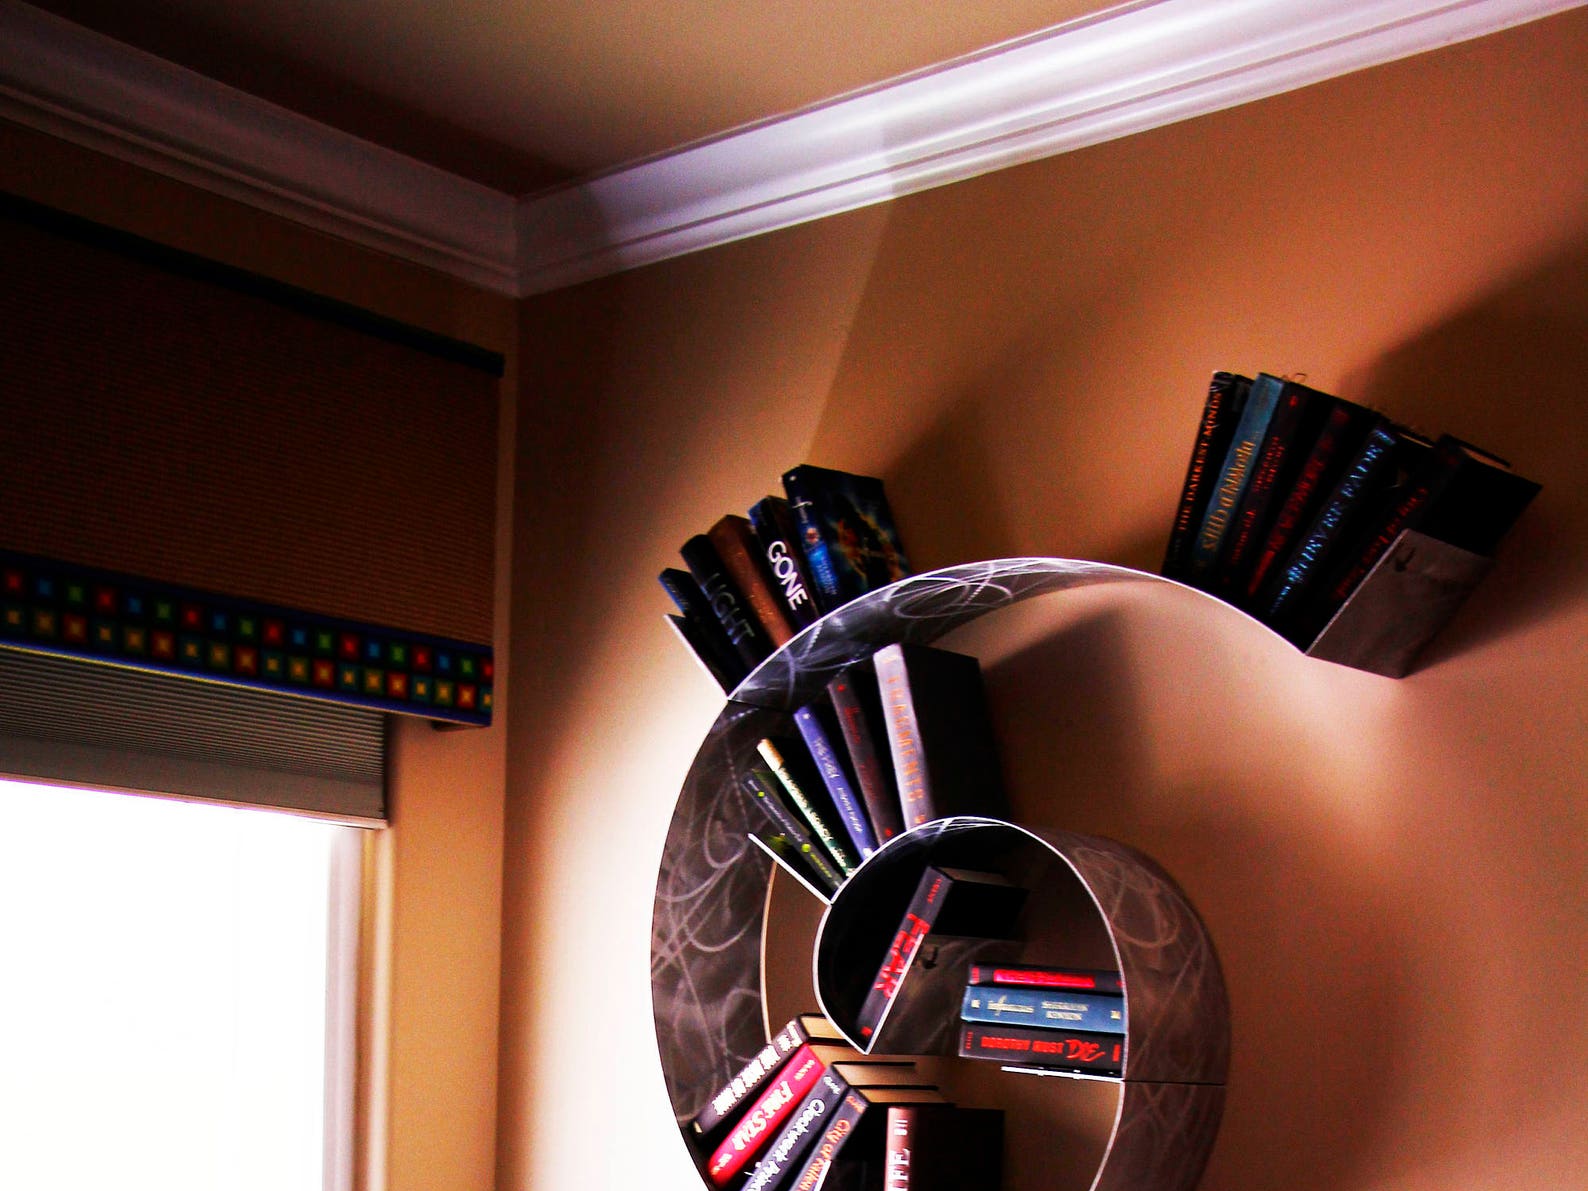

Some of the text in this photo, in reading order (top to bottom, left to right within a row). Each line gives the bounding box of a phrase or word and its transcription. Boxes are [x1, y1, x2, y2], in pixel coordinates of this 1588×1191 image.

[1185, 441, 1211, 501] DARKEST
[1203, 390, 1223, 437] MINDS
[700, 572, 755, 646] LIGHT
[767, 540, 809, 611] GONE
[873, 912, 930, 999] FEAR
[730, 1110, 770, 1153] STAR
[761, 1080, 796, 1120] FIRE
[770, 1097, 827, 1165] Clockwork
[824, 1115, 853, 1147] City
[817, 1141, 838, 1162] of
